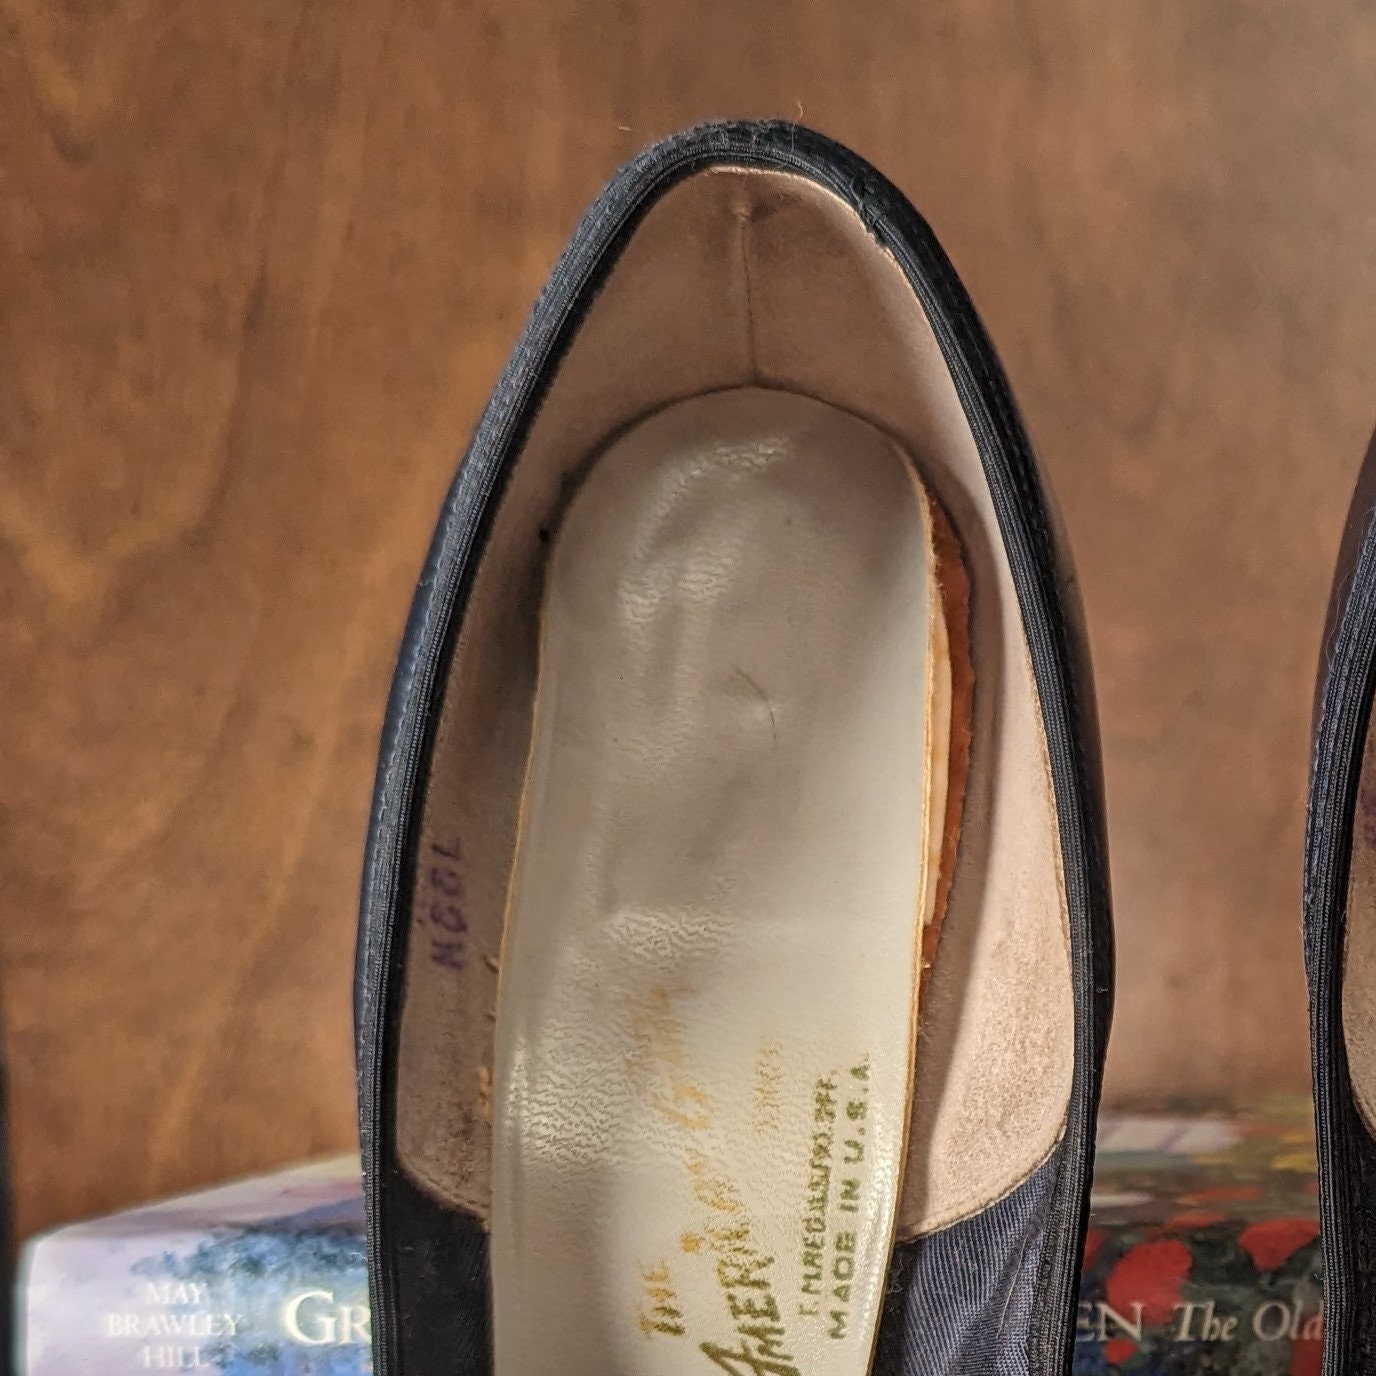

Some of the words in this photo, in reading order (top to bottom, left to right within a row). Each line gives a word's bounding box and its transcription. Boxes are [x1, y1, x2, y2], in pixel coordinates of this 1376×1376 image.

[836, 1178, 861, 1213] IN
[145, 1283, 208, 1305] MAY
[827, 1231, 856, 1340] MADE
[108, 1315, 243, 1337] BRAWLEY
[1173, 1301, 1239, 1341] The
[144, 1347, 211, 1369] HILL
